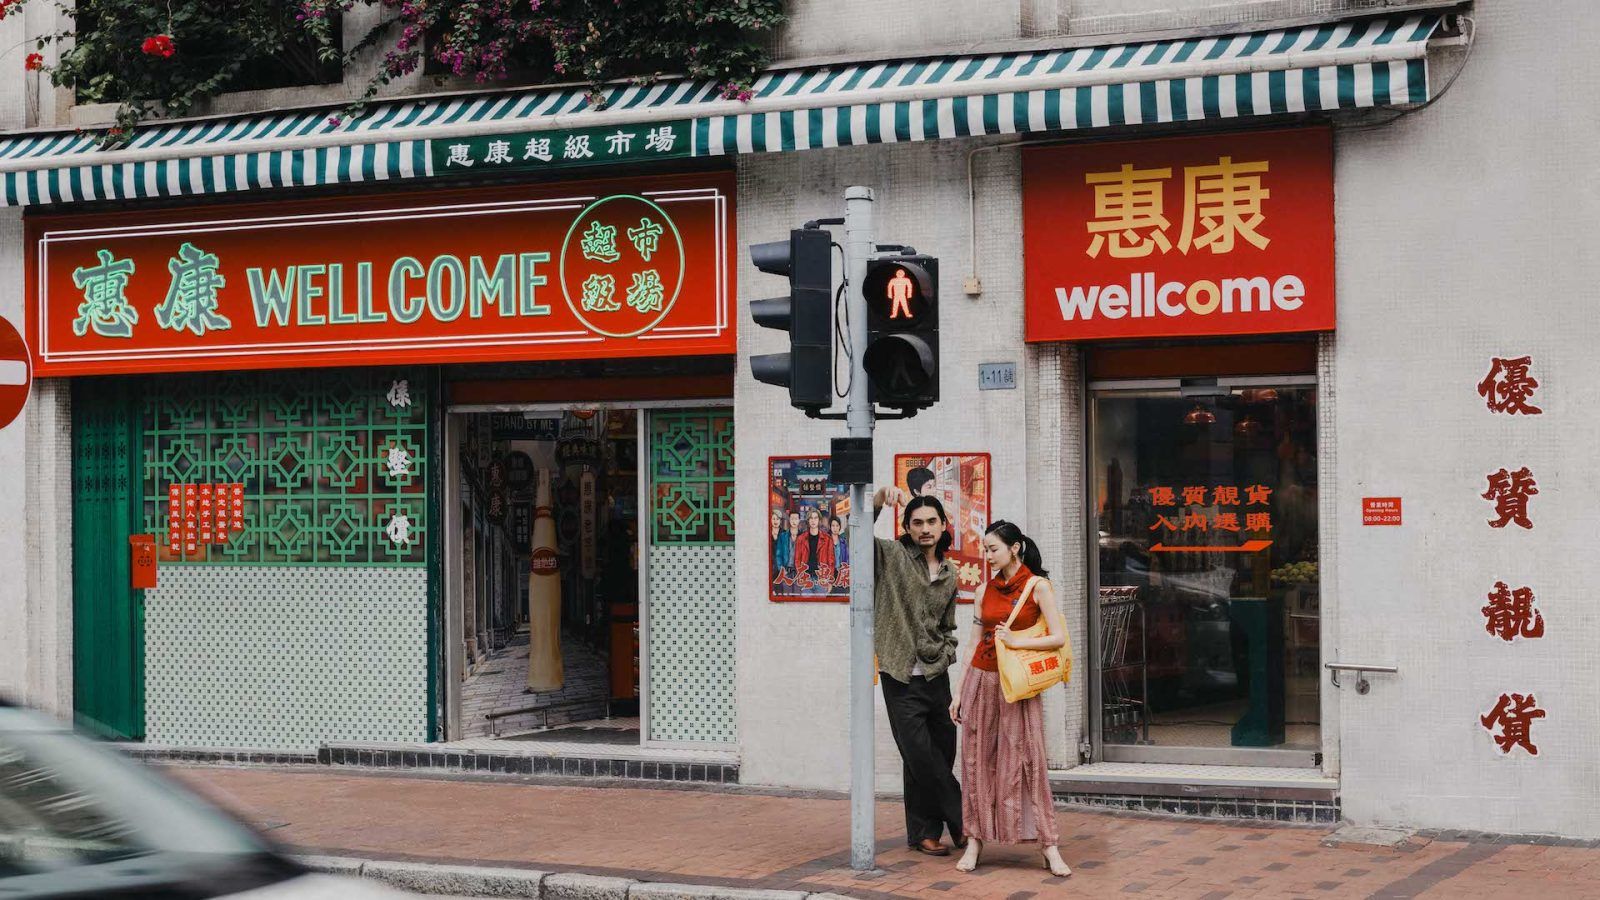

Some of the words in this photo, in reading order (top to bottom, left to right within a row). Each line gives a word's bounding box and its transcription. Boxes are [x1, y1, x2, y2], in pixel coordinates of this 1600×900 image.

[446, 126, 676, 168] 惠康超級市場
[1083, 156, 1271, 260] 惠康
[72, 242, 232, 338] 惠康
[246, 252, 552, 328] WELLCOME
[1055, 272, 1306, 321] wellcome
[492, 415, 524, 430] STAND
[1149, 484, 1273, 506] 優質靚貨
[1149, 513, 1273, 532] 入內選購
[1478, 356, 1545, 756] 優質靚貨
[1028, 656, 1059, 675] 惠康
